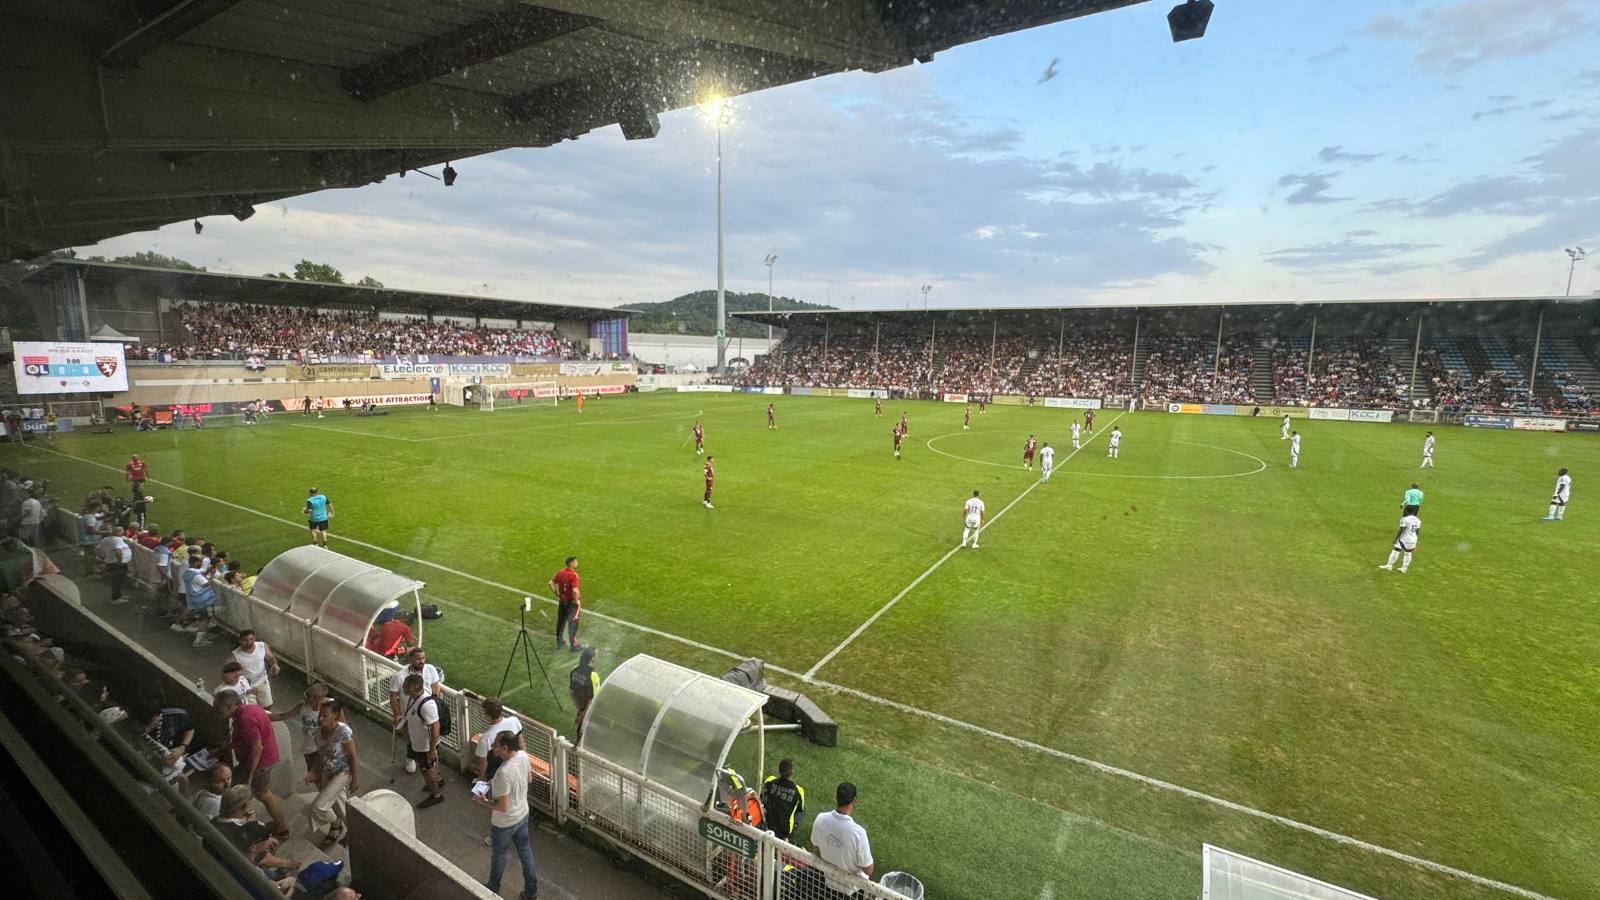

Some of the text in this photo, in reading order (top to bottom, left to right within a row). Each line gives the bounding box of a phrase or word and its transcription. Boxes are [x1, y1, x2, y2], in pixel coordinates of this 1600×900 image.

[26, 364, 49, 375] OL
[306, 368, 315, 376] 21
[383, 364, 432, 374] E.Leclerc
[706, 822, 750, 851] SORTIE
